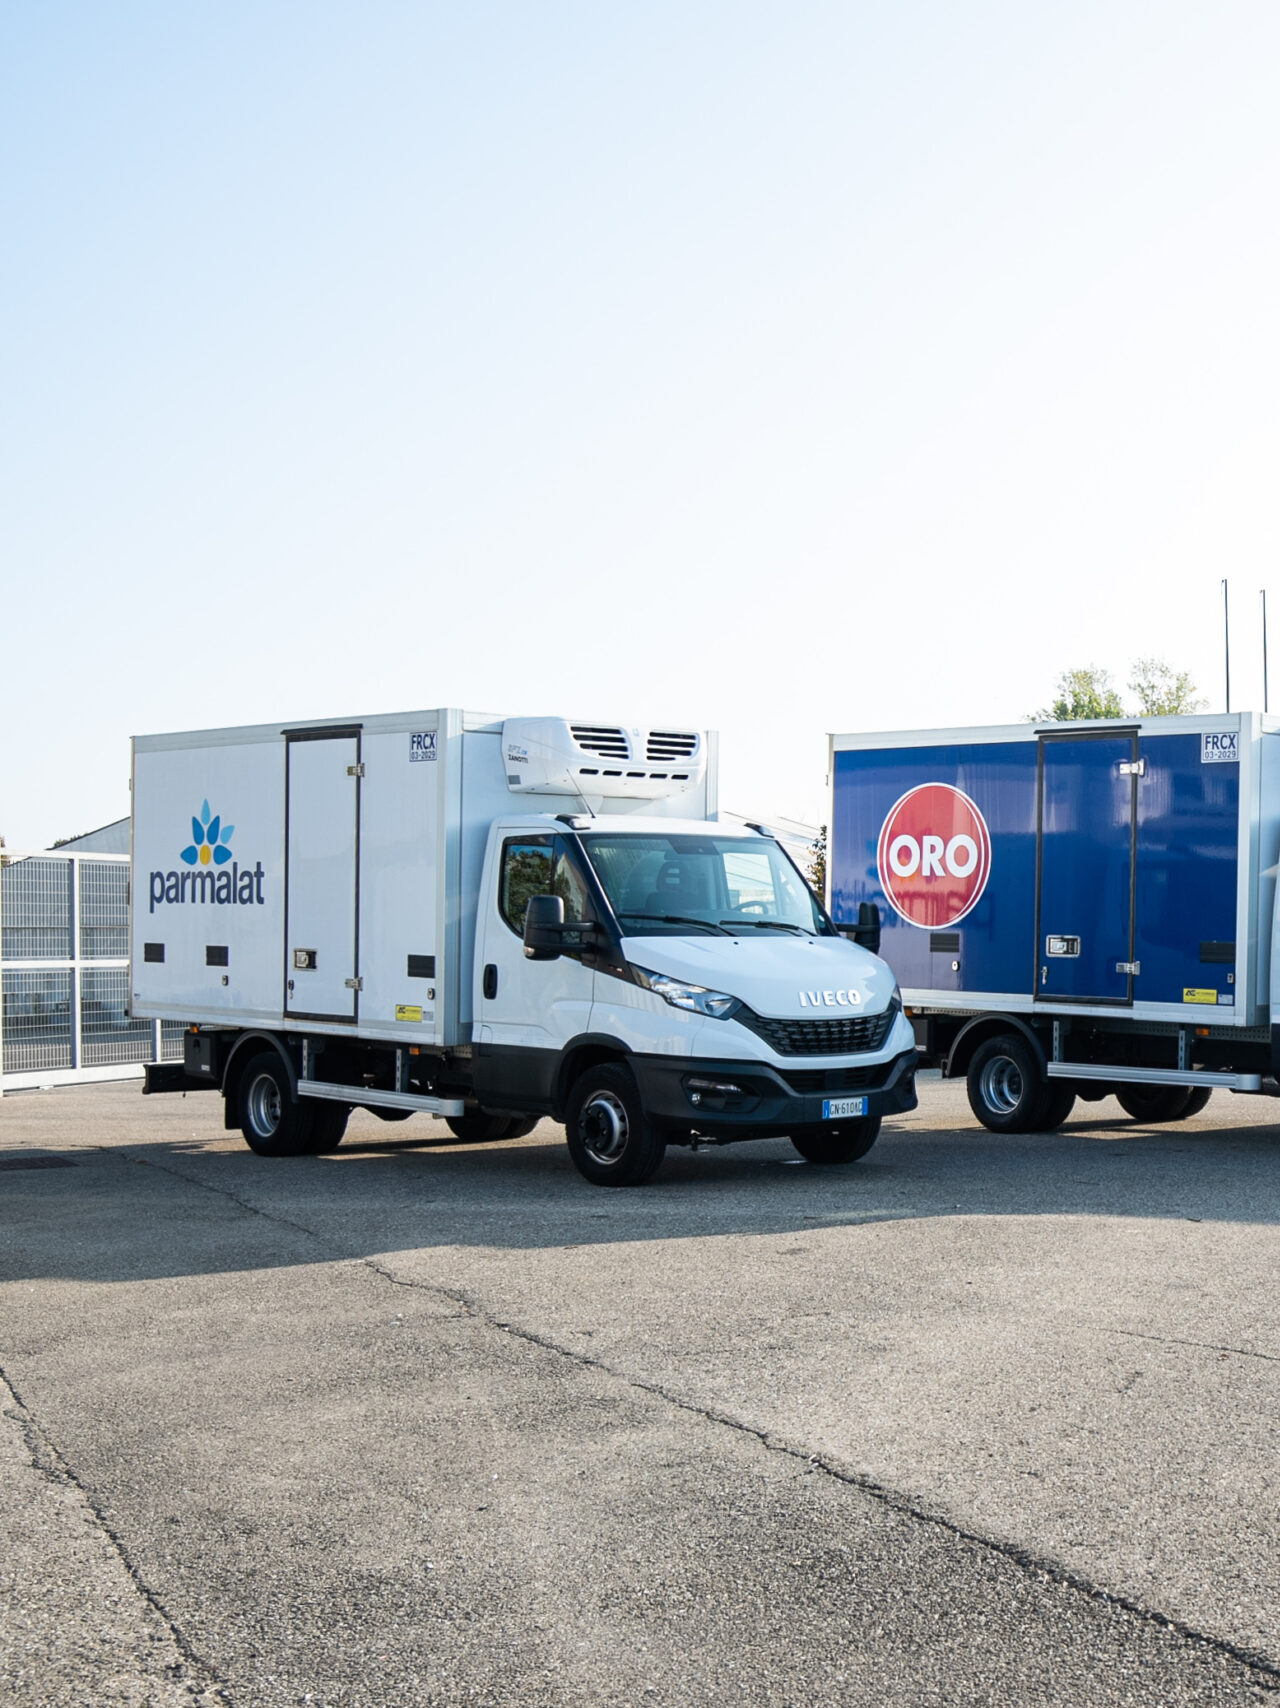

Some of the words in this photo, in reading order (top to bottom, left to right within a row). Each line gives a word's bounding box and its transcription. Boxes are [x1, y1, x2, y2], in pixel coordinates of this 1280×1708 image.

[411, 733, 435, 750] FRCX
[1205, 734, 1236, 750] FRCX
[1205, 751, 1236, 759] 03-2029
[889, 834, 978, 878] ORO
[148, 861, 265, 914] parmalat
[798, 989, 861, 1007] IVECO
